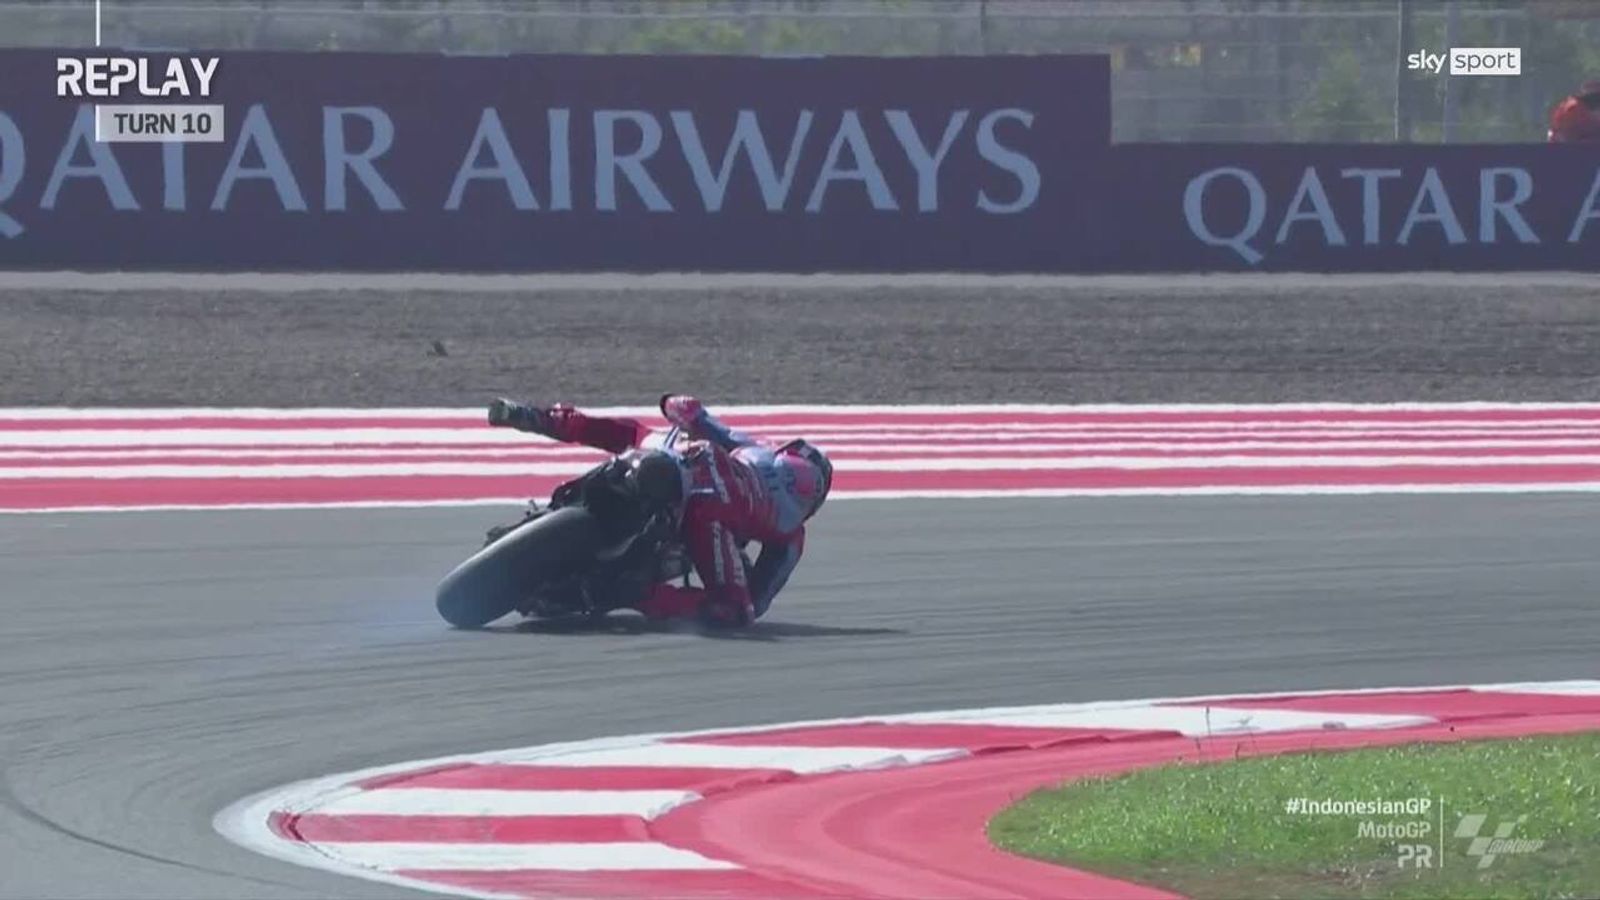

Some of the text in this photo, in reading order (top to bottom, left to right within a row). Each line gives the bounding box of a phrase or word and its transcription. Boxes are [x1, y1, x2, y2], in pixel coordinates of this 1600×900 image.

[0, 104, 1042, 239] ATAR AIRWAYS
[1183, 166, 1541, 264] QATAR
